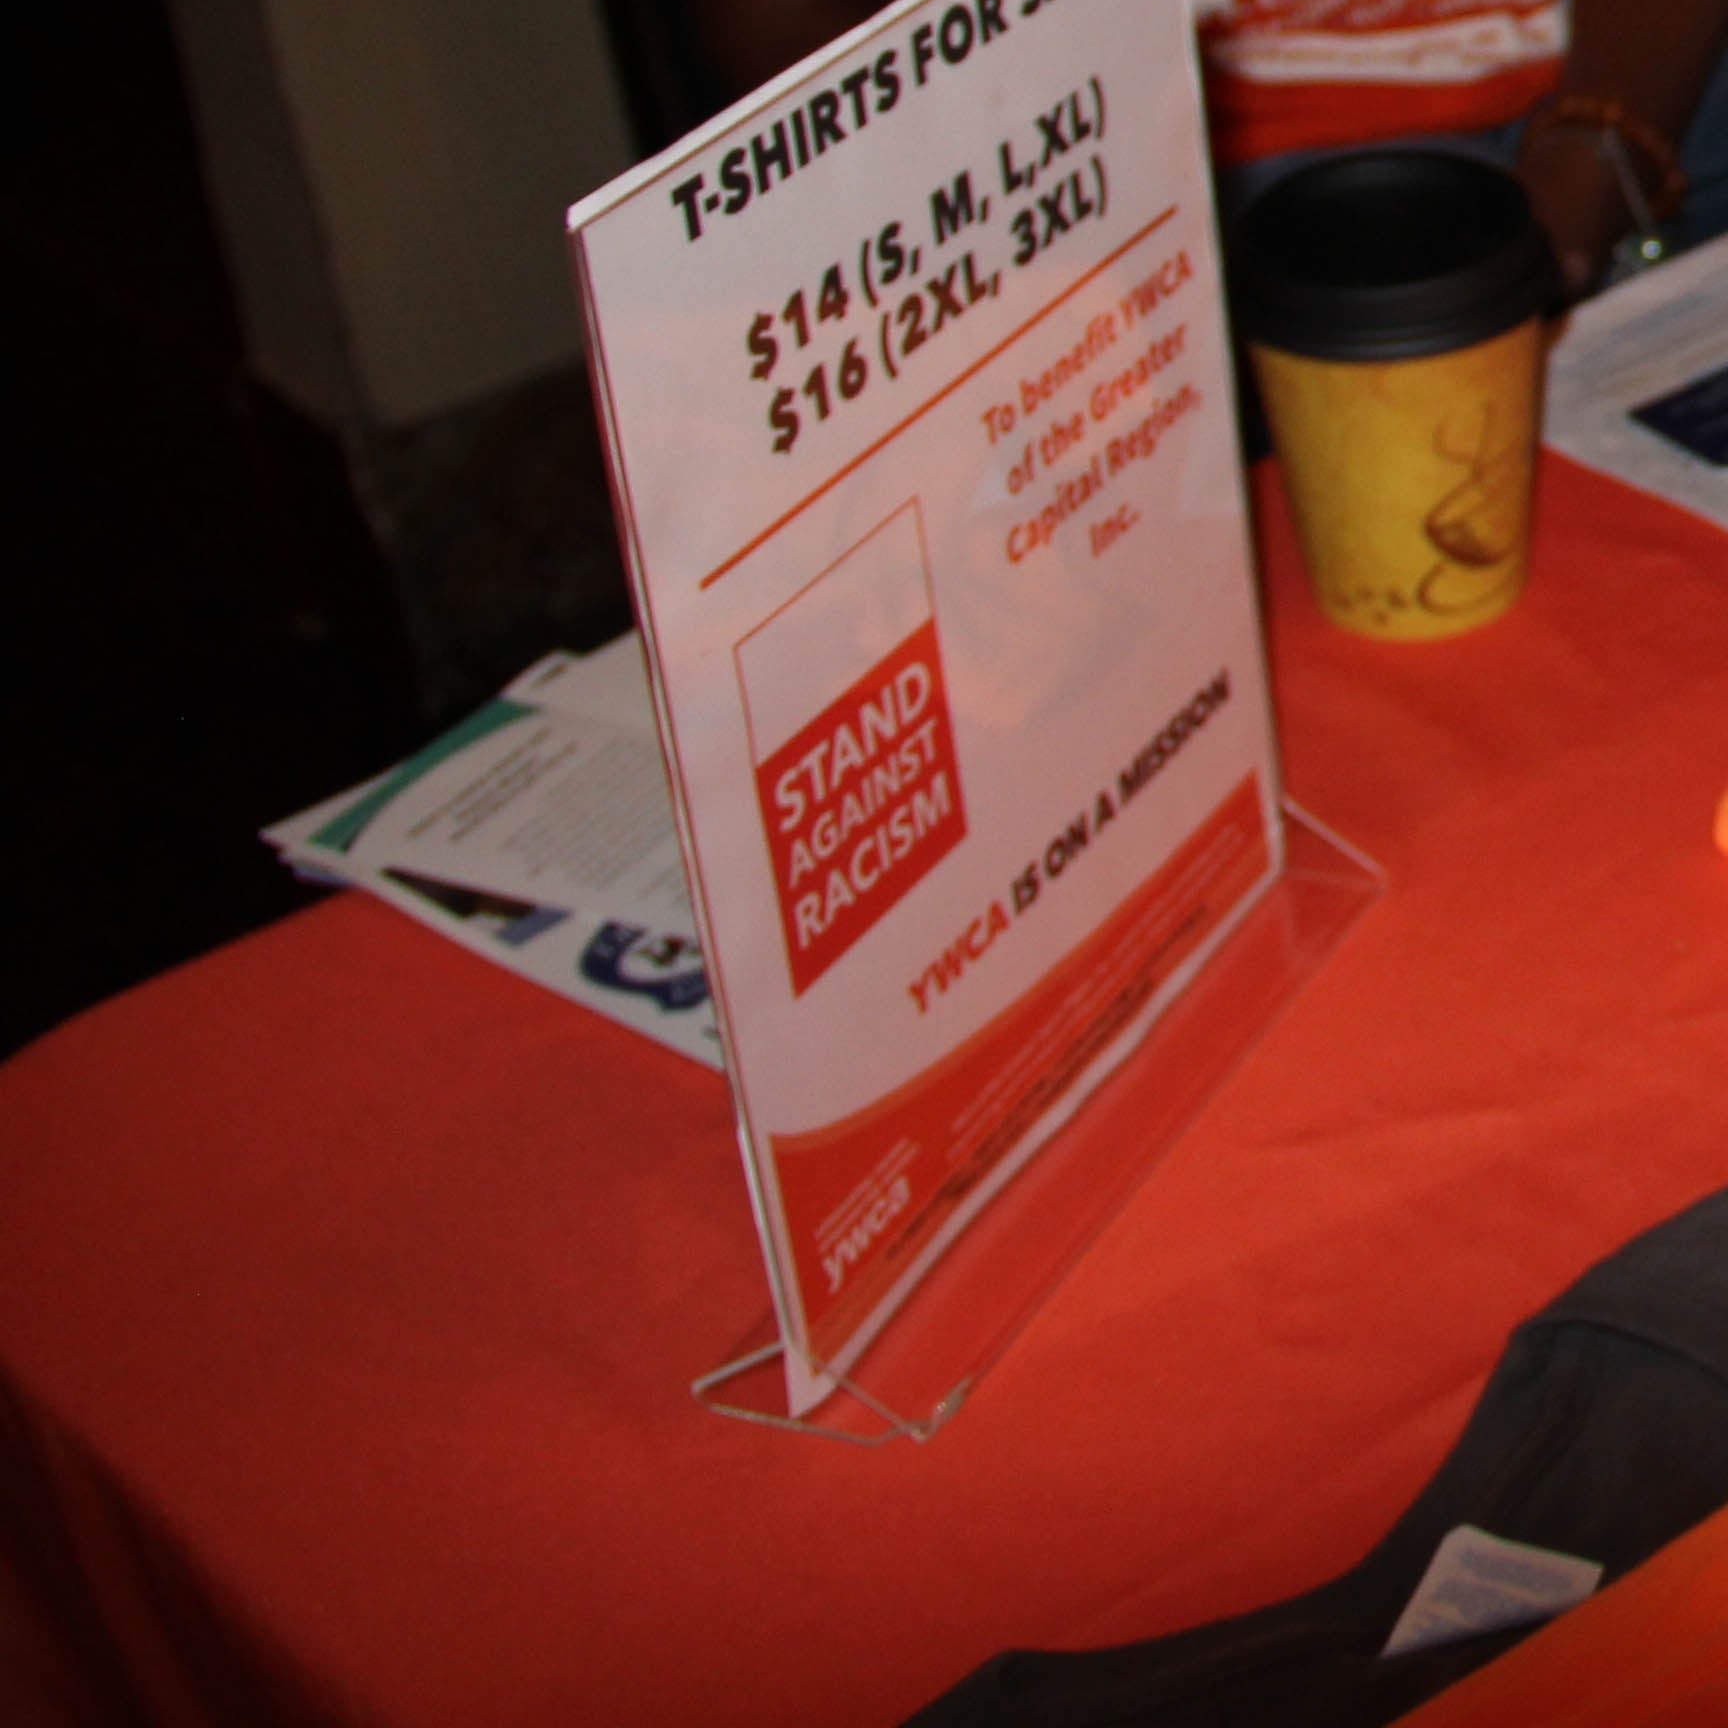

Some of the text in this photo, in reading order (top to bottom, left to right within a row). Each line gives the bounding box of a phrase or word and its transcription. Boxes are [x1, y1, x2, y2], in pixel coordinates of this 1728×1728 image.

[672, 50, 901, 242] T-SHIRTS
[746, 262, 849, 382] $14
[930, 171, 991, 247] M,
[771, 155, 1108, 456] $16 (2XL, 3XL)
[981, 250, 1194, 445] To benefit YWCA
[1007, 324, 1187, 494] of the Greater
[1007, 455, 1103, 563] Capital
[774, 662, 931, 833] STAND
[789, 719, 938, 888] AGAINST
[794, 770, 951, 949] RACISM
[907, 667, 1232, 1015] YWCA IS ON A MISSION
